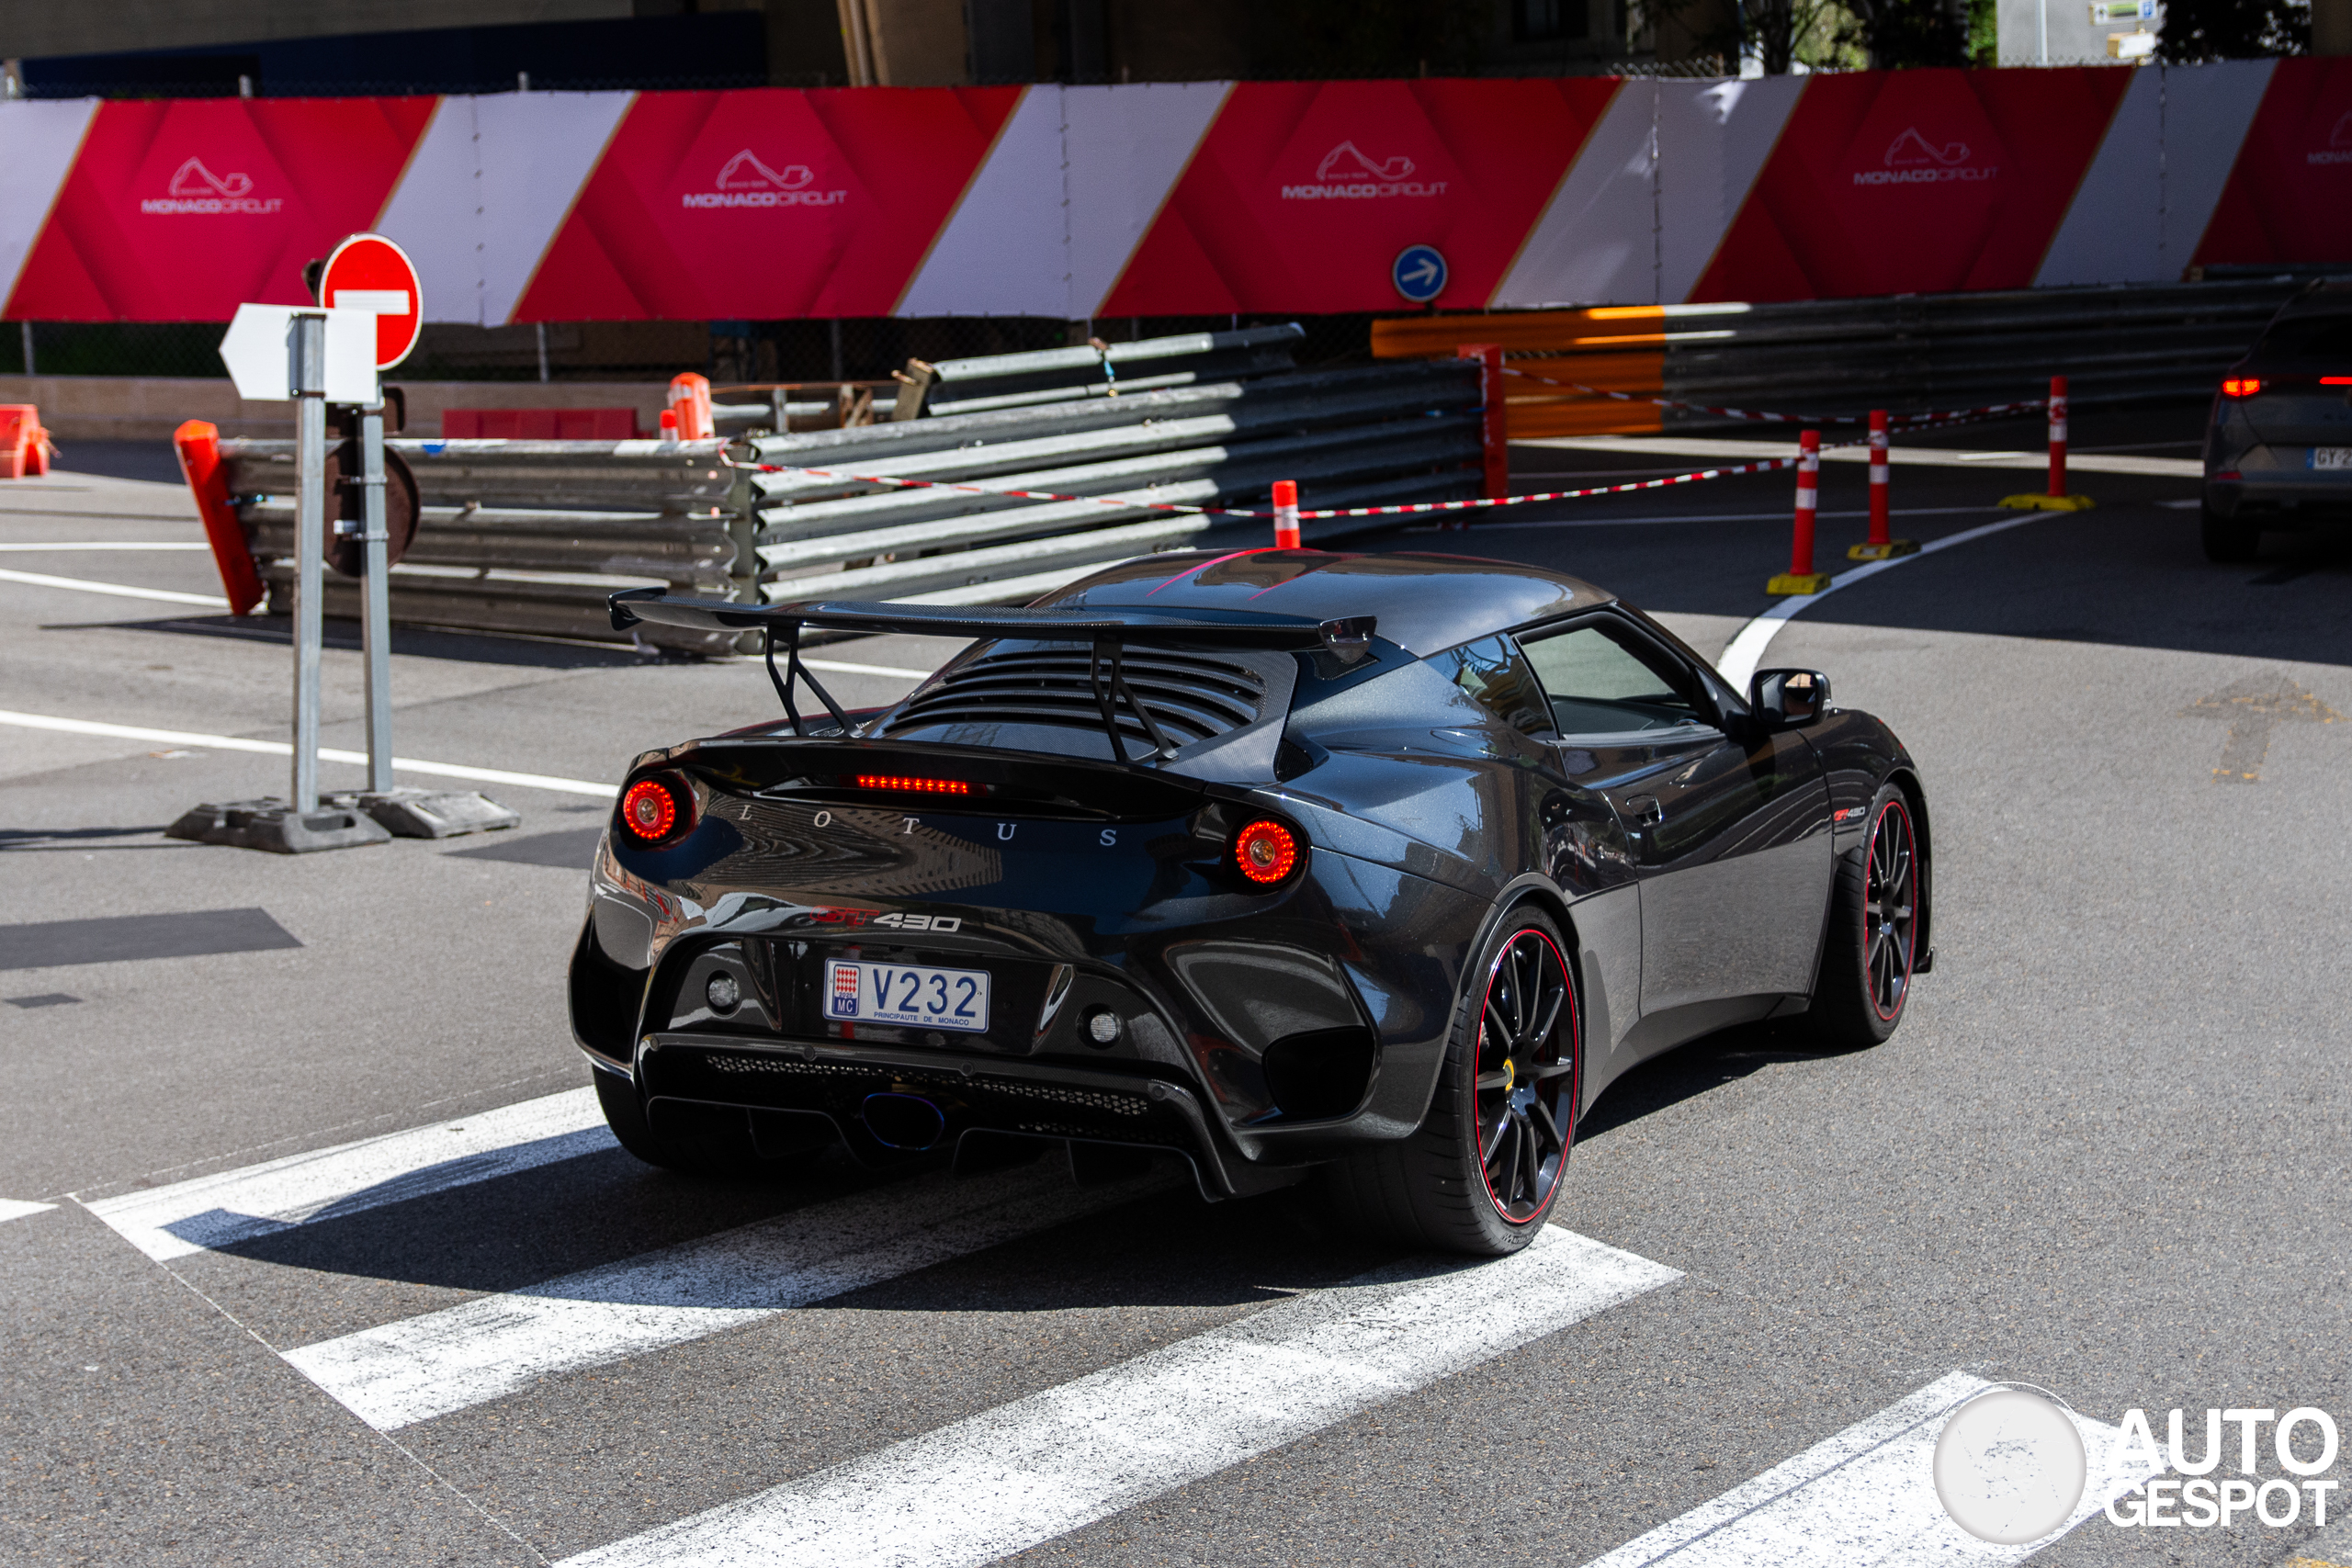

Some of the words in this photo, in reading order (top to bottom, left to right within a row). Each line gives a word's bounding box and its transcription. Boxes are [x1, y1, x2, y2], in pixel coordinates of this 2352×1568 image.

[739, 804, 1117, 846] LOTUS
[837, 998, 854, 1013] MC
[873, 968, 977, 1018] V232
[874, 1011, 918, 1021] PRINCIPAUTE
[938, 1018, 969, 1026] MONACO
